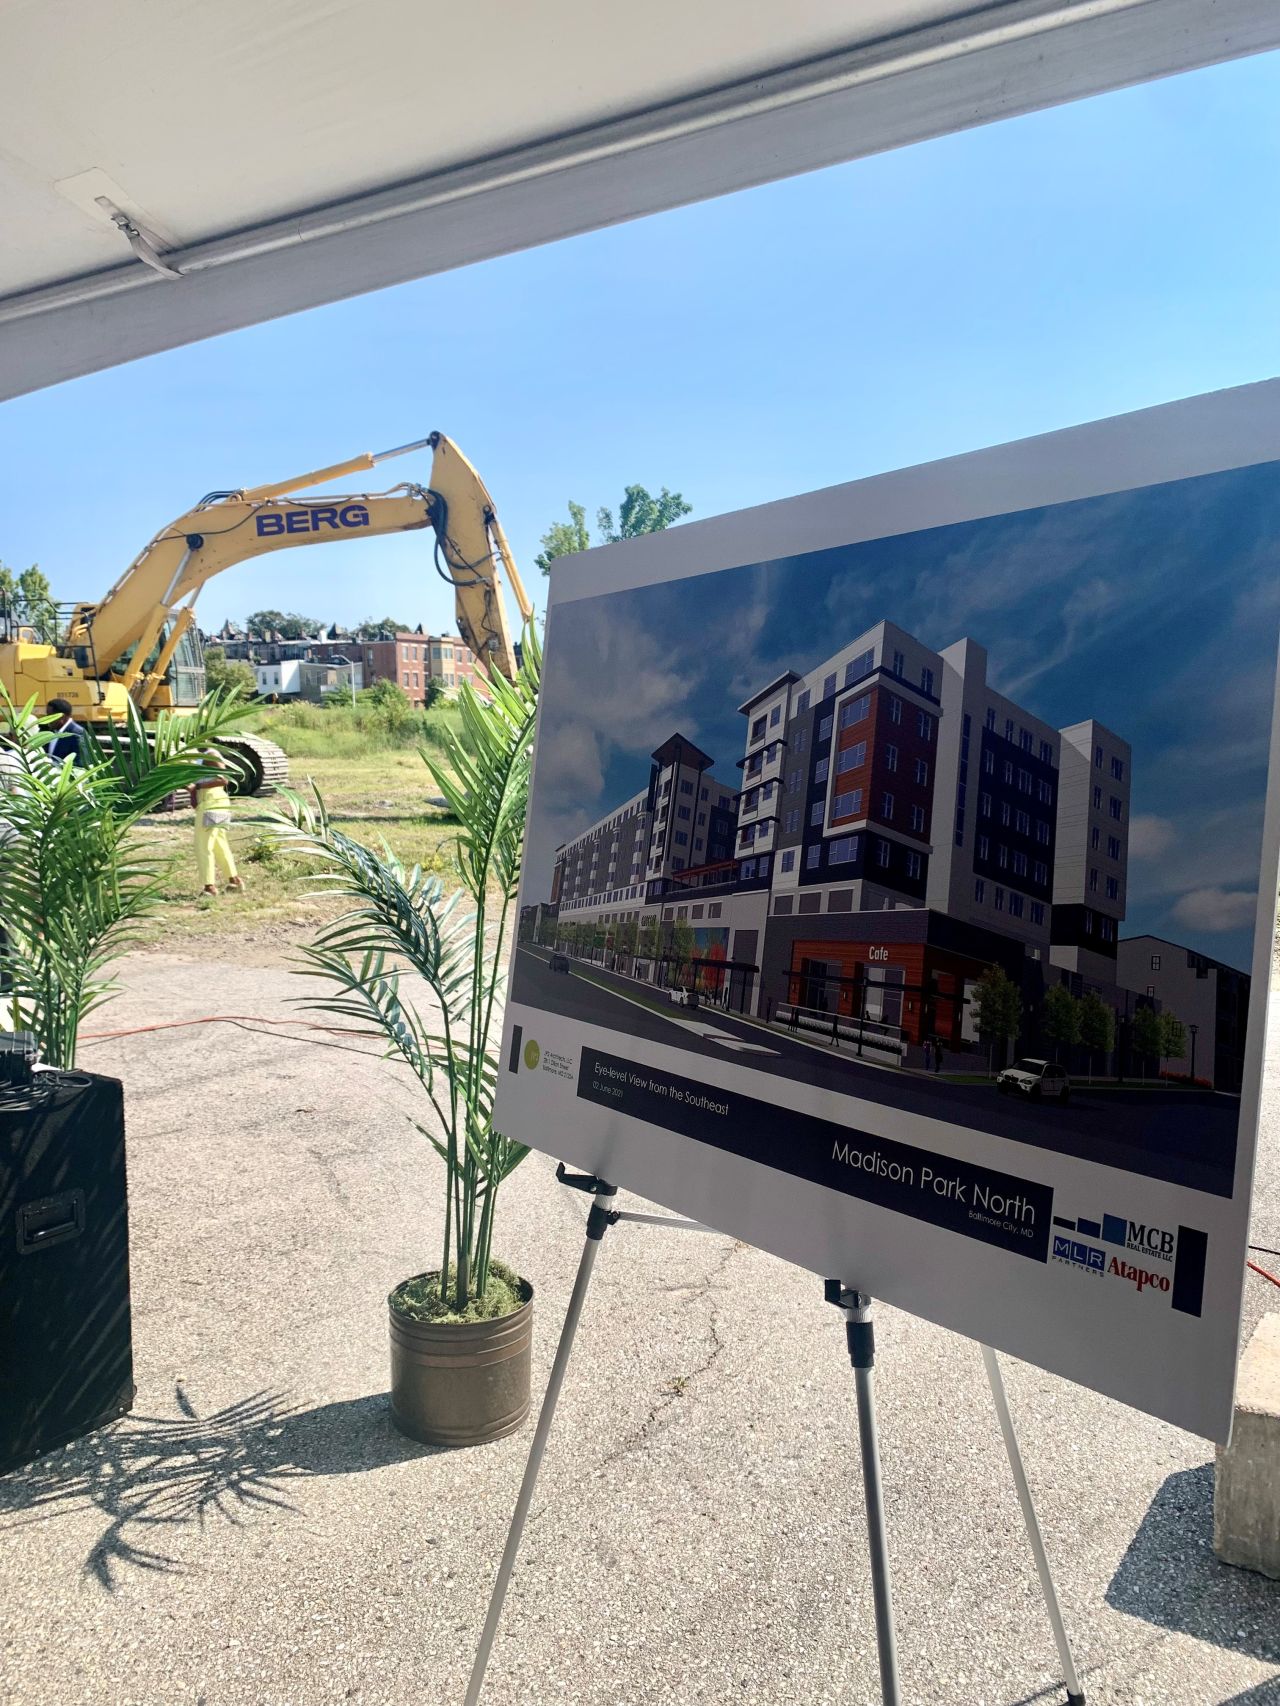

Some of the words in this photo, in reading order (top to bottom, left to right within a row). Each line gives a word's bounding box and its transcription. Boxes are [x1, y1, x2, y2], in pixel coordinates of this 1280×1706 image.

[256, 505, 370, 536] BERG
[869, 946, 889, 960] Cafe
[592, 1080, 599, 1091] 02
[599, 1083, 612, 1095] June
[594, 1062, 627, 1083] Eye-level
[629, 1072, 648, 1089] View
[649, 1079, 668, 1096] from
[669, 1086, 683, 1101] the
[684, 1092, 729, 1116] Southeast
[831, 1140, 914, 1185] Madison
[920, 1167, 966, 1203] Park
[973, 1183, 1035, 1225] North
[968, 1210, 1001, 1228] Baltimore
[1002, 1220, 1019, 1236] City,
[1020, 1226, 1034, 1238] MD
[1127, 1221, 1175, 1254] MCB
[1051, 1255, 1105, 1277] PARTNERS
[1054, 1239, 1103, 1267] MLR
[1126, 1242, 1141, 1253] REAL
[1141, 1246, 1162, 1259] ESTATE
[1162, 1252, 1173, 1263] LLC
[1107, 1256, 1170, 1292] Atapco
